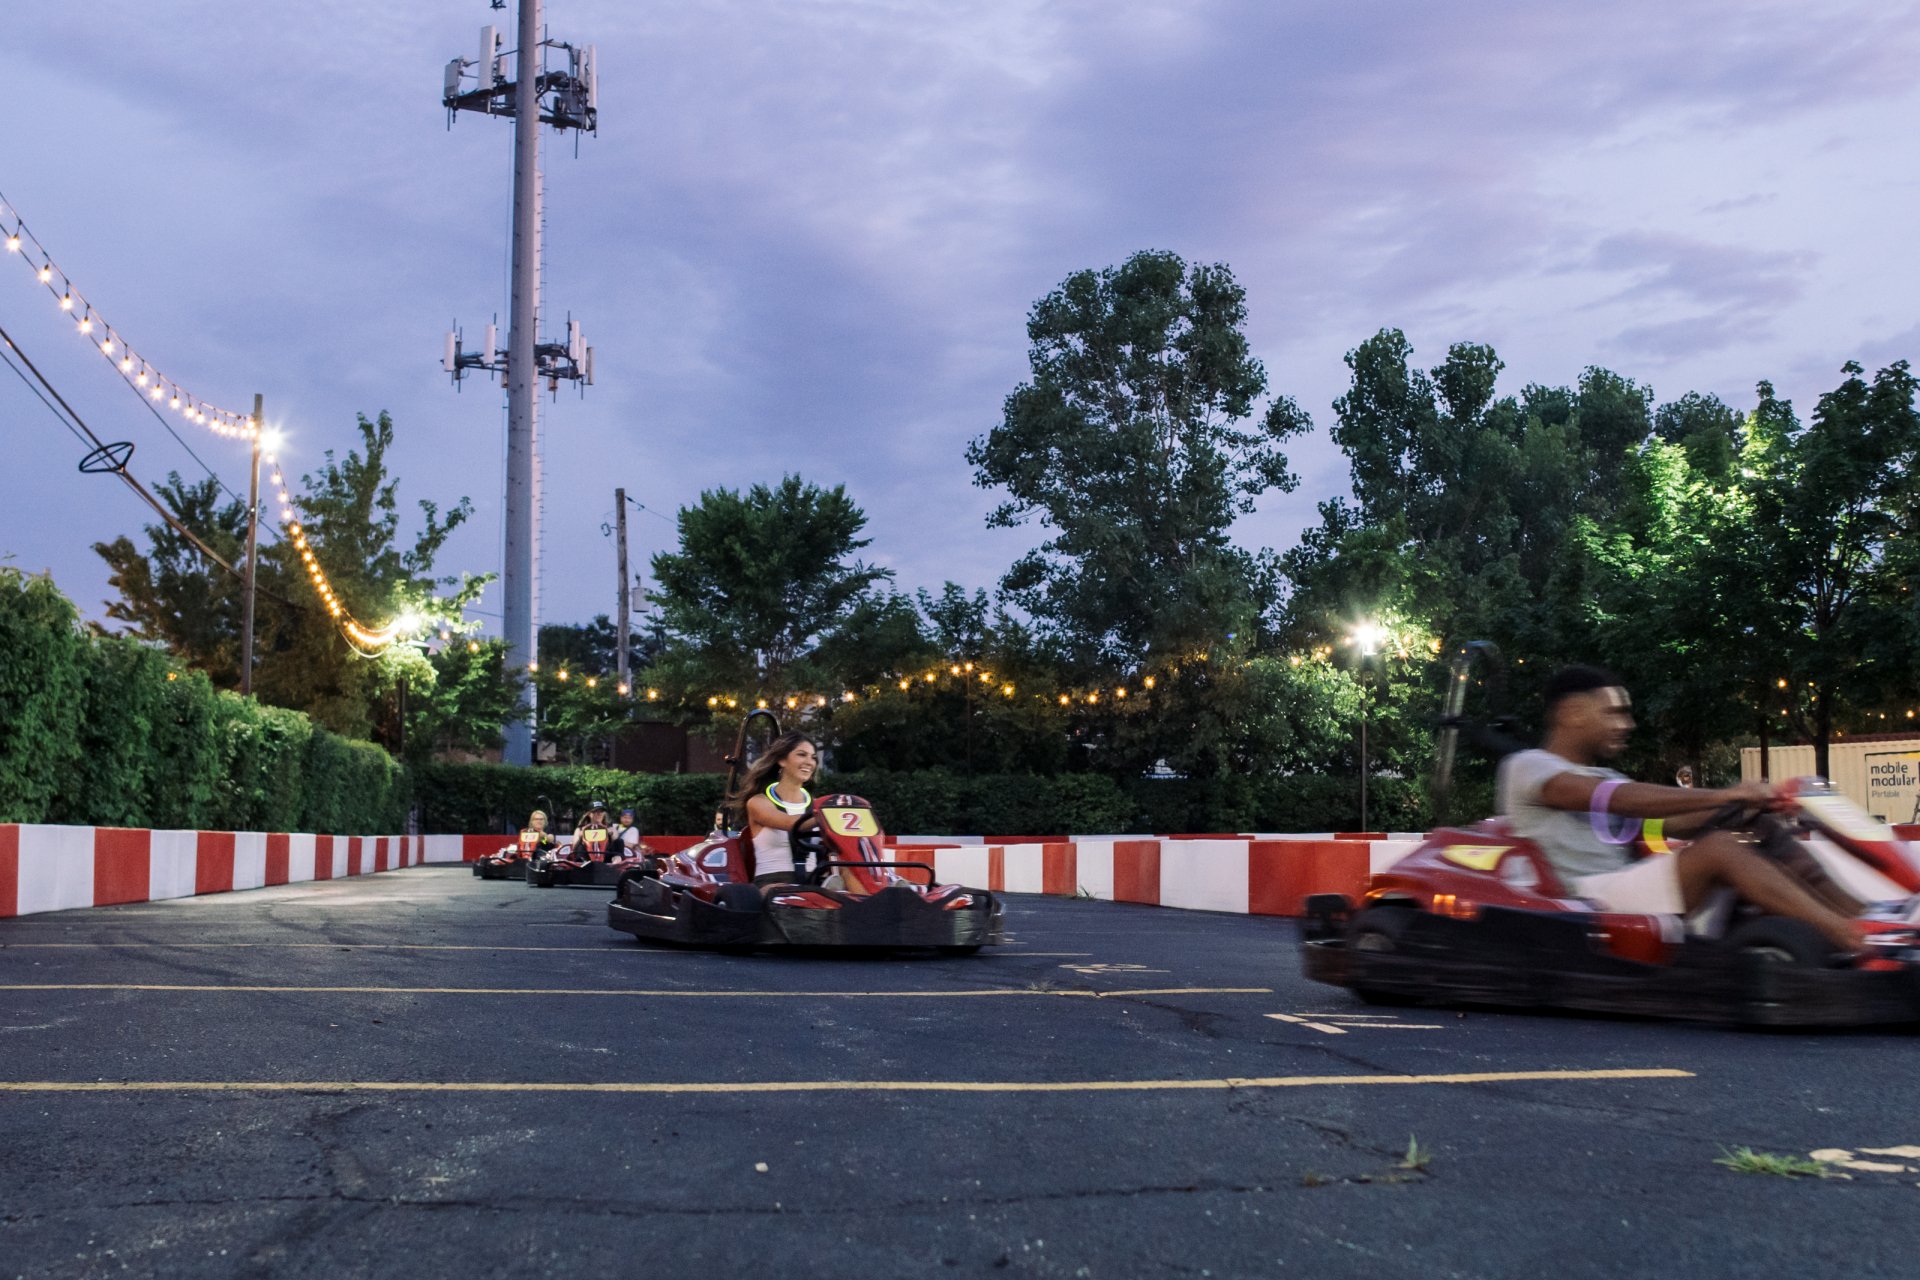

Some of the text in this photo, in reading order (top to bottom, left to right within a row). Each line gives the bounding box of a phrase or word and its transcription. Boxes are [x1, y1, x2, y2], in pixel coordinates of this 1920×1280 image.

[1870, 762, 1908, 774] mobile
[1871, 774, 1917, 787] modular
[841, 811, 863, 832] 2
